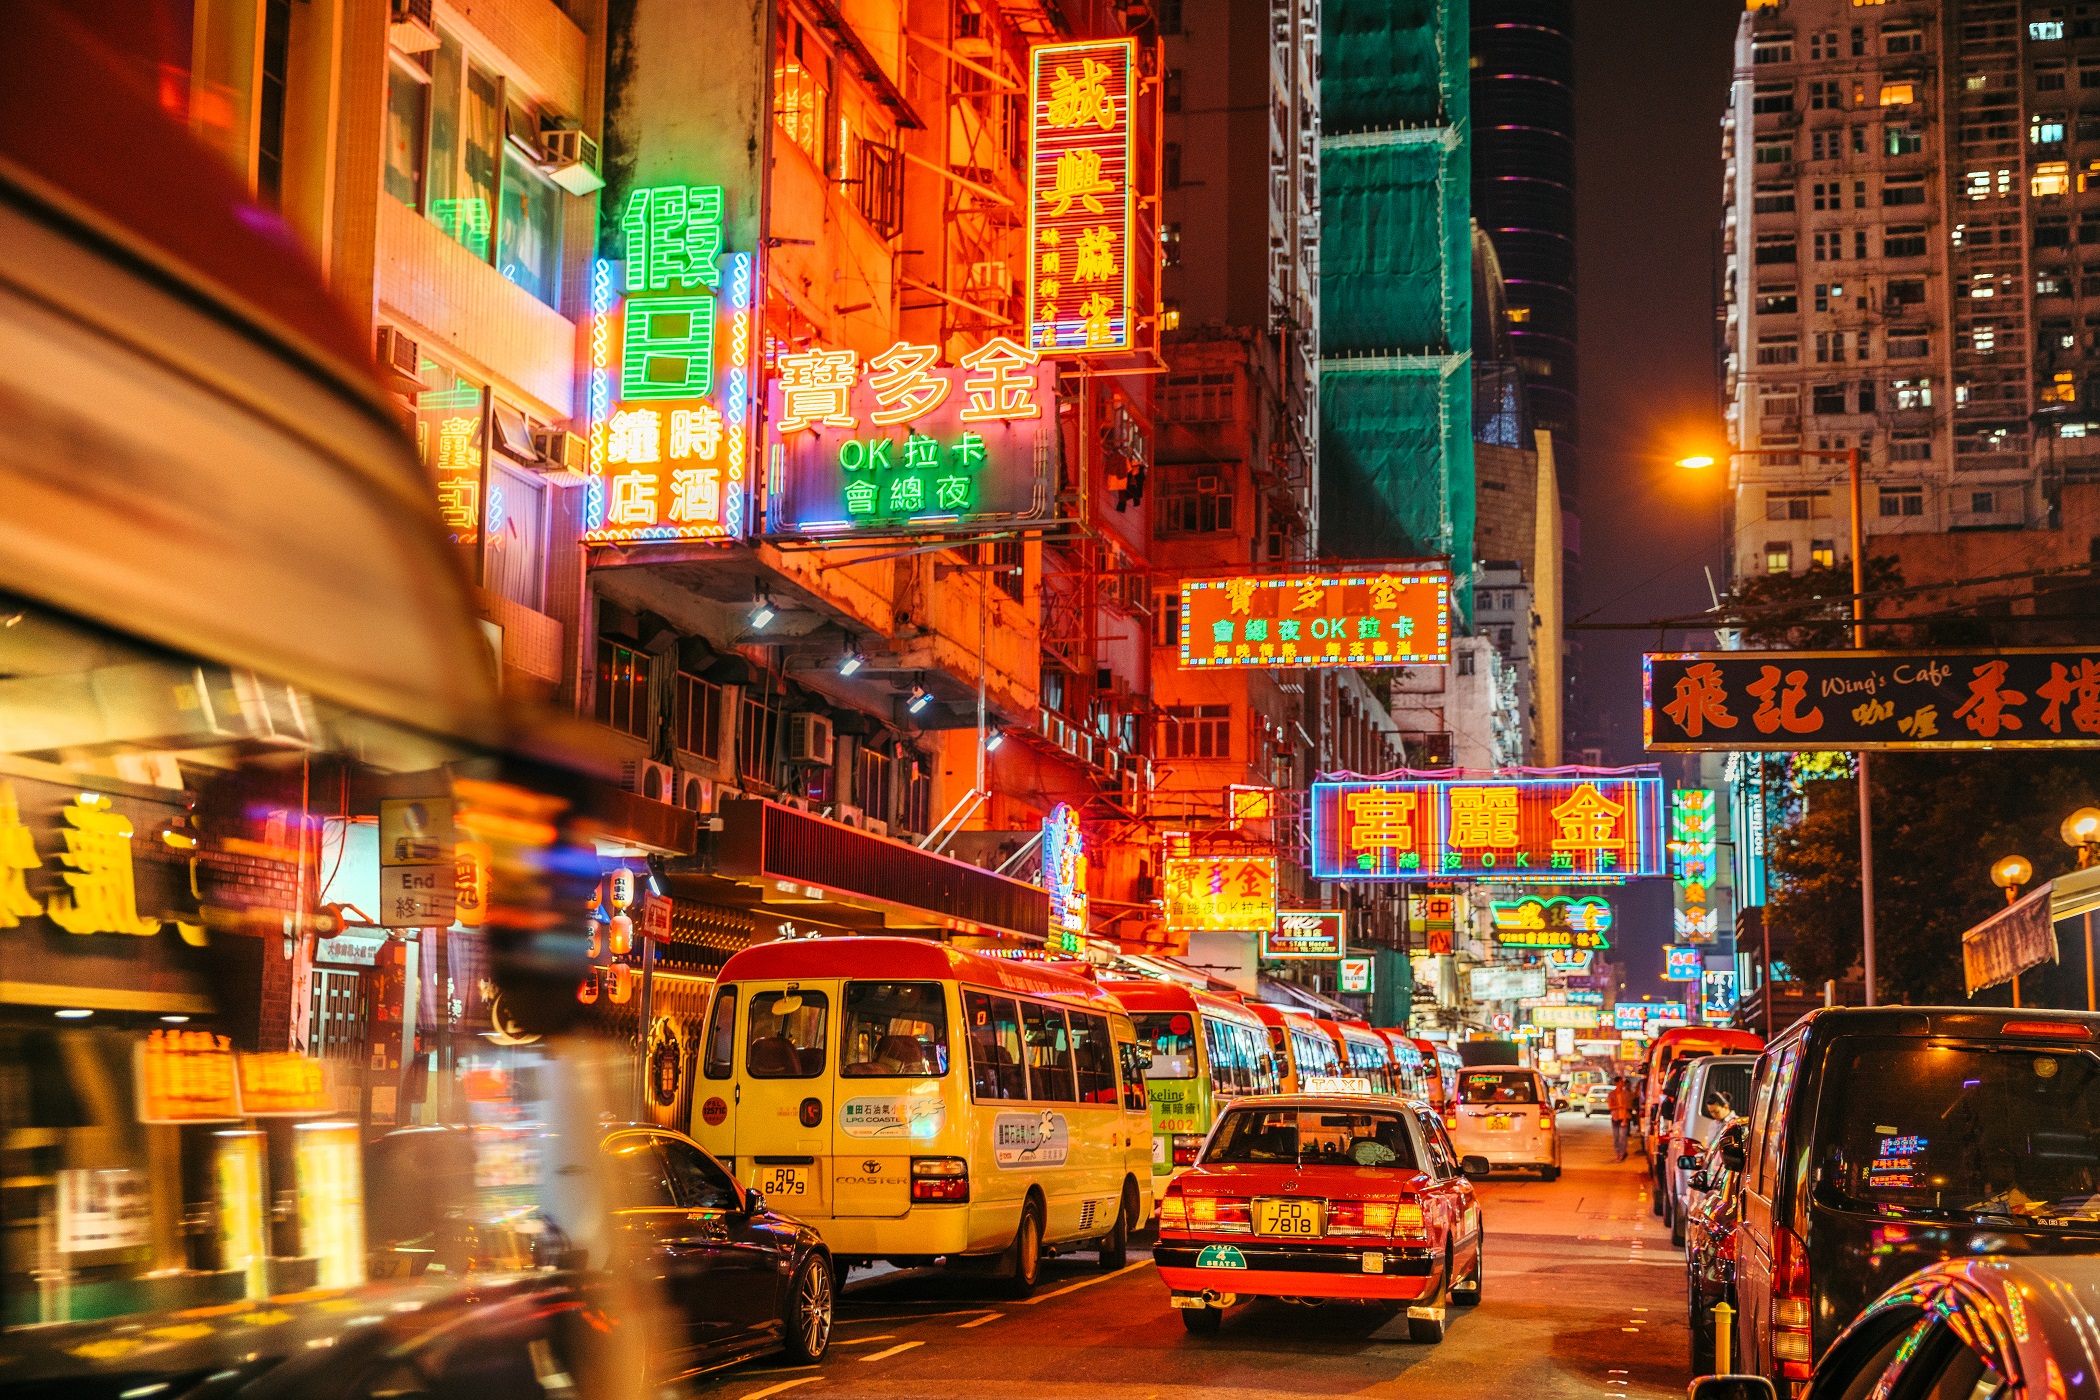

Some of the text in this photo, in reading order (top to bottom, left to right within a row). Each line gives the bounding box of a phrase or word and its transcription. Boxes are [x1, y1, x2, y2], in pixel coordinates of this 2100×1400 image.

[1822, 664, 1953, 698] Wing's Cafe
[1662, 662, 1824, 738] 飛記
[402, 873, 435, 889] End
[1312, 1079, 1363, 1092] TAXI
[1147, 1088, 1185, 1101] keline
[1158, 1119, 1194, 1131] 4002
[775, 1170, 796, 1181] RD
[836, 1177, 907, 1185] COASTER
[765, 1182, 805, 1195] 8479
[1278, 1204, 1302, 1218] FD
[1268, 1218, 1311, 1233] 7818
[1215, 1250, 1226, 1261] 4
